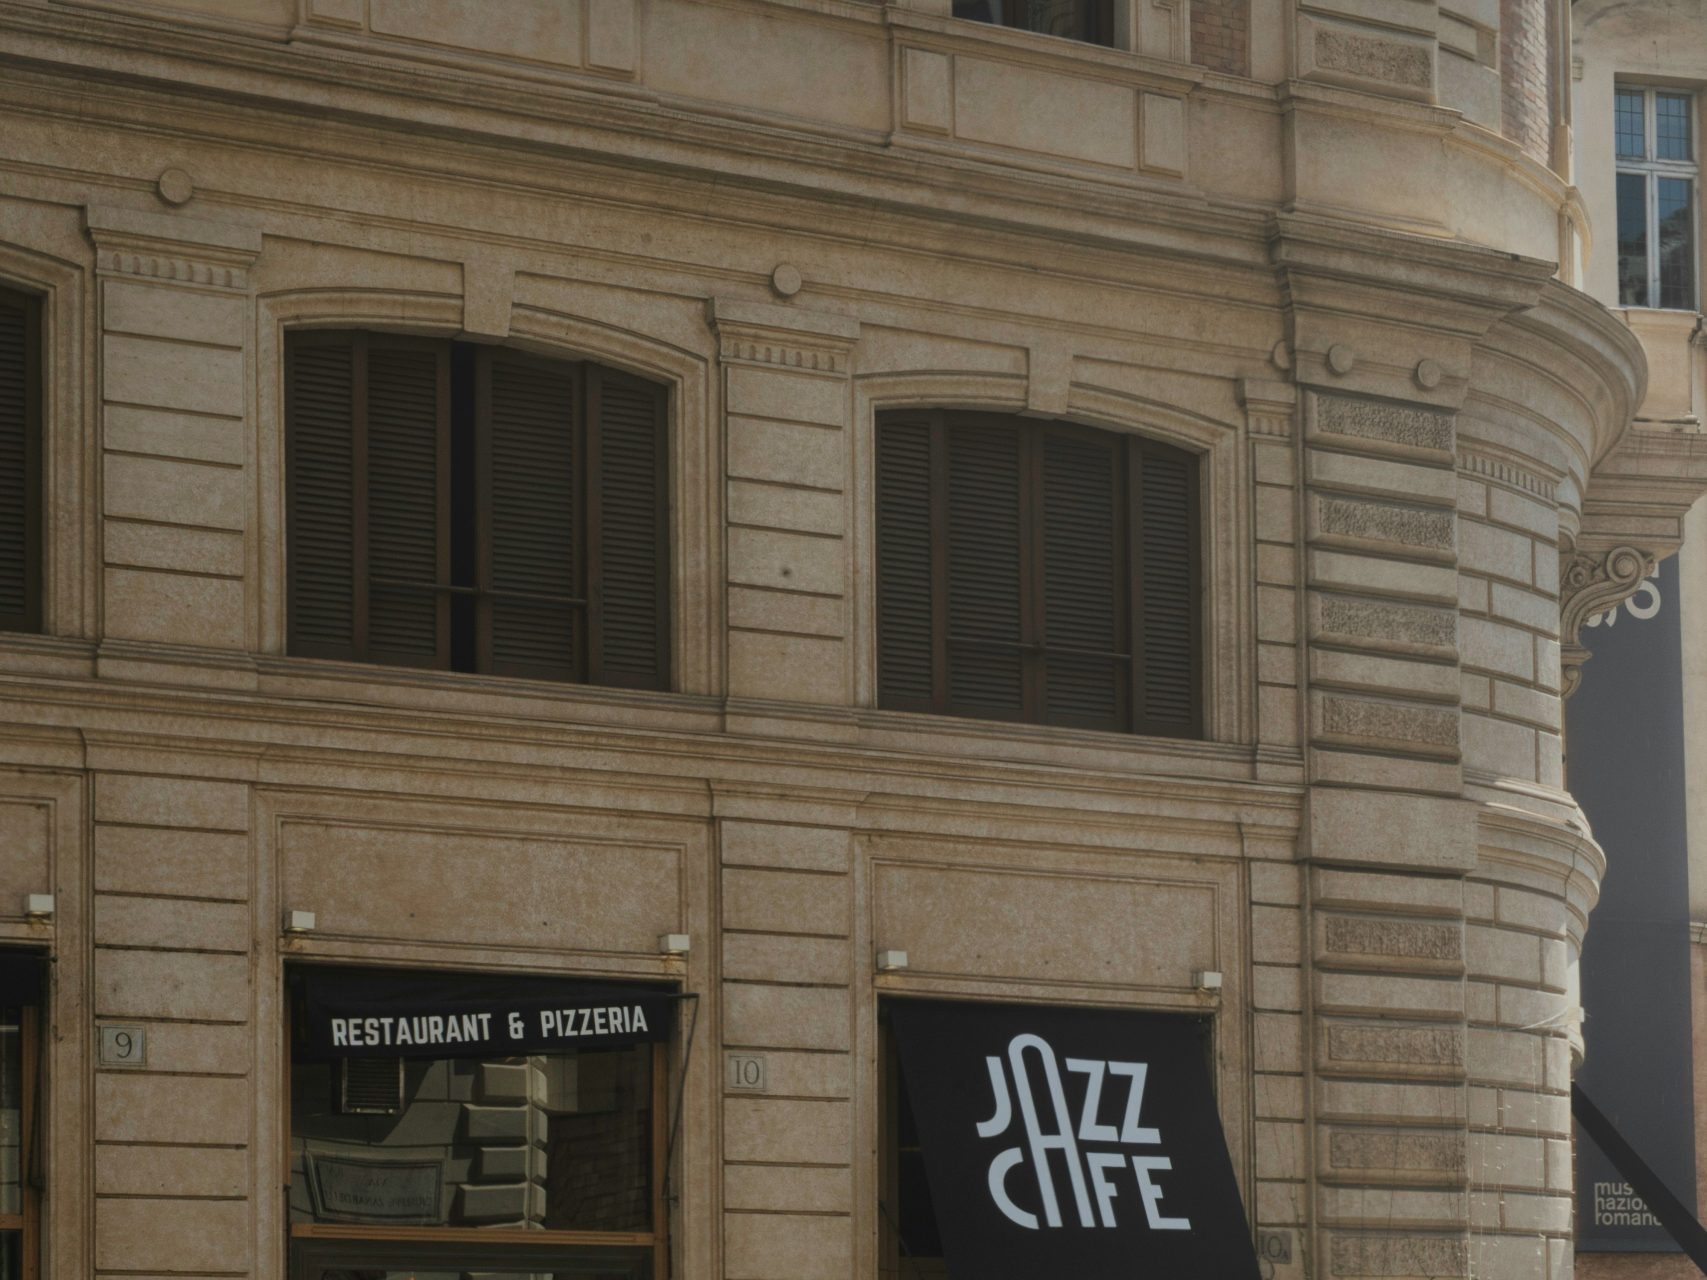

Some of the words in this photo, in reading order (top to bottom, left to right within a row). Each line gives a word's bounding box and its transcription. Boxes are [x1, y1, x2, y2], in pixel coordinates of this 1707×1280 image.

[331, 1013, 492, 1047] RESTAURANT
[508, 1012, 525, 1040] &
[540, 1005, 649, 1038] PIZZERIA
[115, 1032, 132, 1059] 9
[736, 1060, 760, 1085] 10
[975, 1033, 1162, 1144] JAZZ
[988, 1146, 1192, 1230] CAFE
[1594, 1182, 1635, 1196] mus
